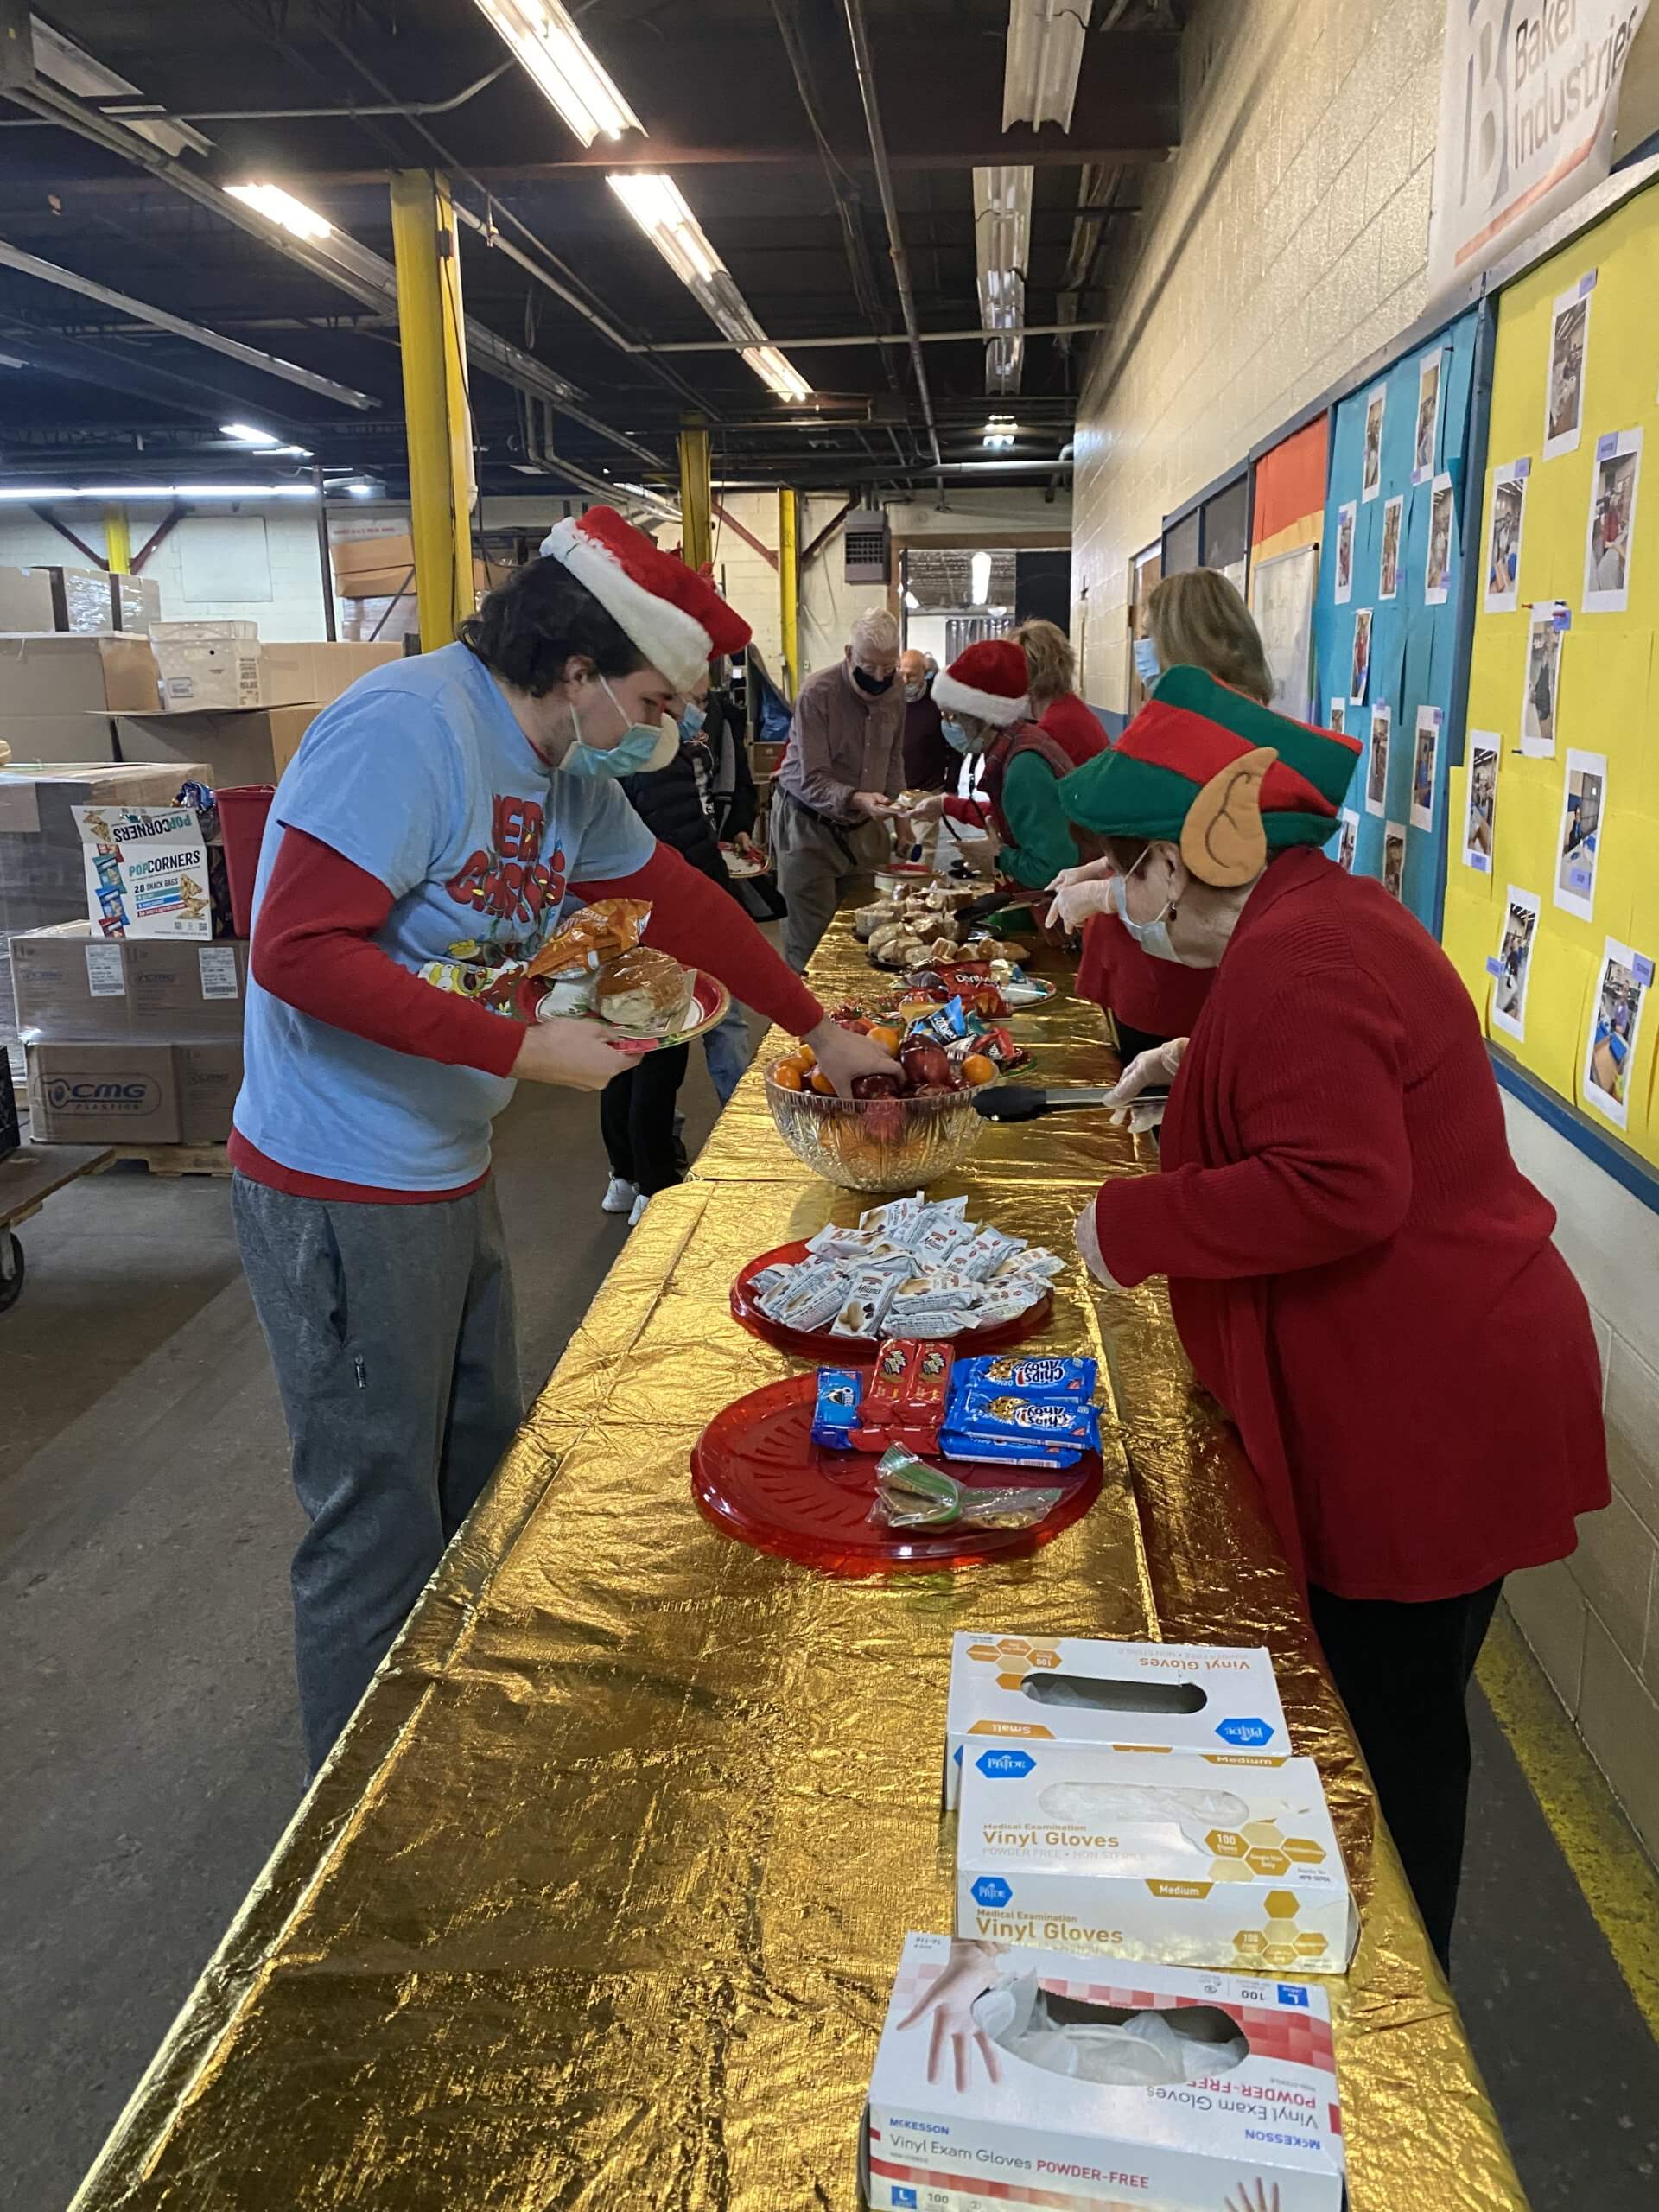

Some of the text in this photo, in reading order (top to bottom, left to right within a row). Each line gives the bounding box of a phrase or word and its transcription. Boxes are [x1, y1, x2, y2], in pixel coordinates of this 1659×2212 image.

[114, 814, 192, 842] POPCORNERS
[129, 850, 200, 877] POPCORNERS
[72, 1083, 146, 1099] CMG
[1140, 1657, 1250, 1669] Vinyl Gloves
[993, 1724, 1031, 1734] Small
[988, 1756, 1027, 1771] PRIDE
[1216, 1756, 1273, 1766] Medium
[982, 1832, 1120, 1847] Vinyl Gloves
[1217, 1834, 1236, 1844] 100
[1159, 1885, 1199, 1897] Medium
[977, 1908, 1077, 1923] Medical Examination
[976, 1917, 1123, 1943] Vinyl Gloves
[1241, 1990, 1266, 2001] 100
[1147, 2085, 1319, 2130] Vinyl Exam Gloves
[890, 2133, 927, 2153] Vinyl
[931, 2140, 973, 2160] Exam
[976, 2148, 1033, 2170] Gloves
[1036, 2159, 1149, 2189] POWDER-FREE
[898, 2189, 909, 2201] L
[927, 2192, 950, 2205] 100
